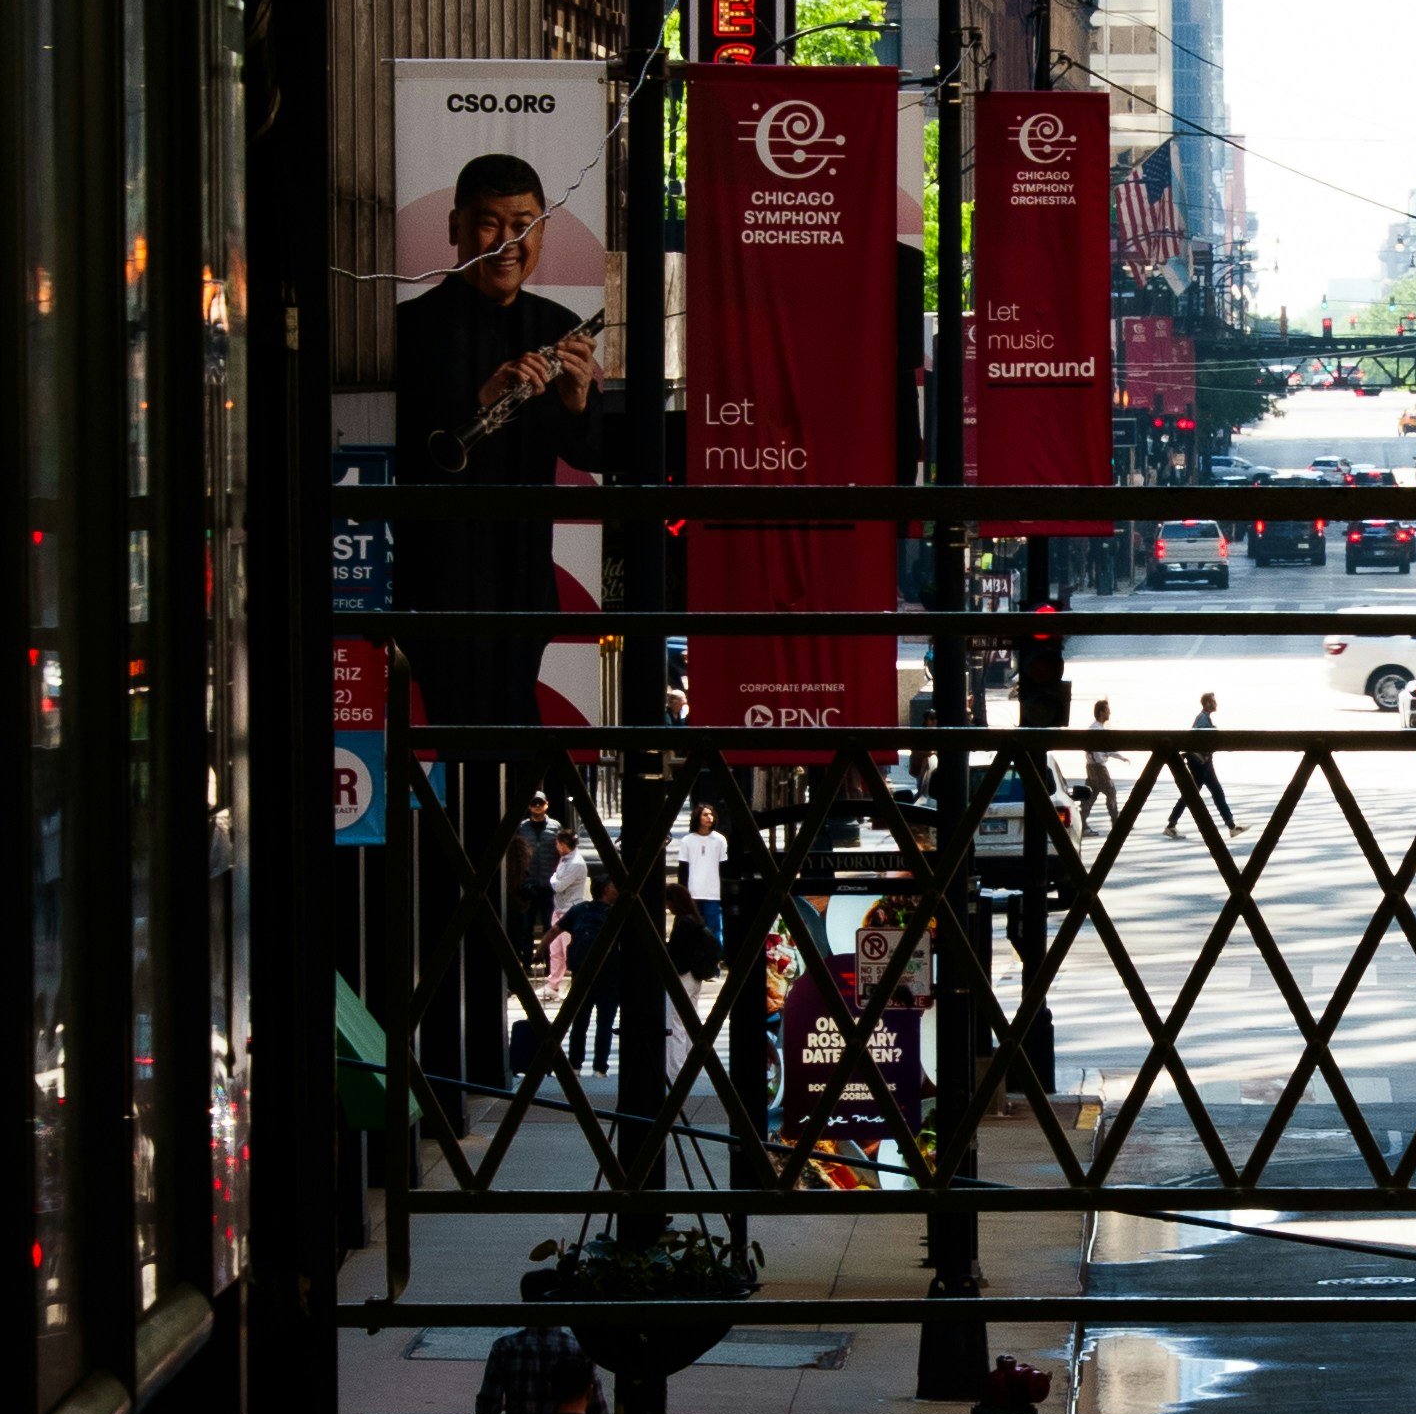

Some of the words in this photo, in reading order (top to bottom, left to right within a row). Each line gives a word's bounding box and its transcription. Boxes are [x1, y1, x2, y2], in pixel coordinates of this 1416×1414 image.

[446, 93, 556, 113] CSO.ORG
[1016, 171, 1070, 180] CHICAGO
[1012, 183, 1075, 193] SYMPHONY
[751, 191, 834, 206] CHICAGO
[1010, 195, 1077, 205] ORCHESTRA
[744, 210, 841, 225] SYMPHONY
[741, 230, 844, 244] ORCHESTRA
[988, 300, 1020, 321] Let
[988, 330, 1055, 350] music
[987, 356, 1095, 378] surround
[706, 393, 754, 425] Let
[705, 440, 807, 470] music
[739, 683, 799, 692] CORPORATE
[801, 683, 845, 692] PARTNER
[778, 708, 841, 728] PNC
